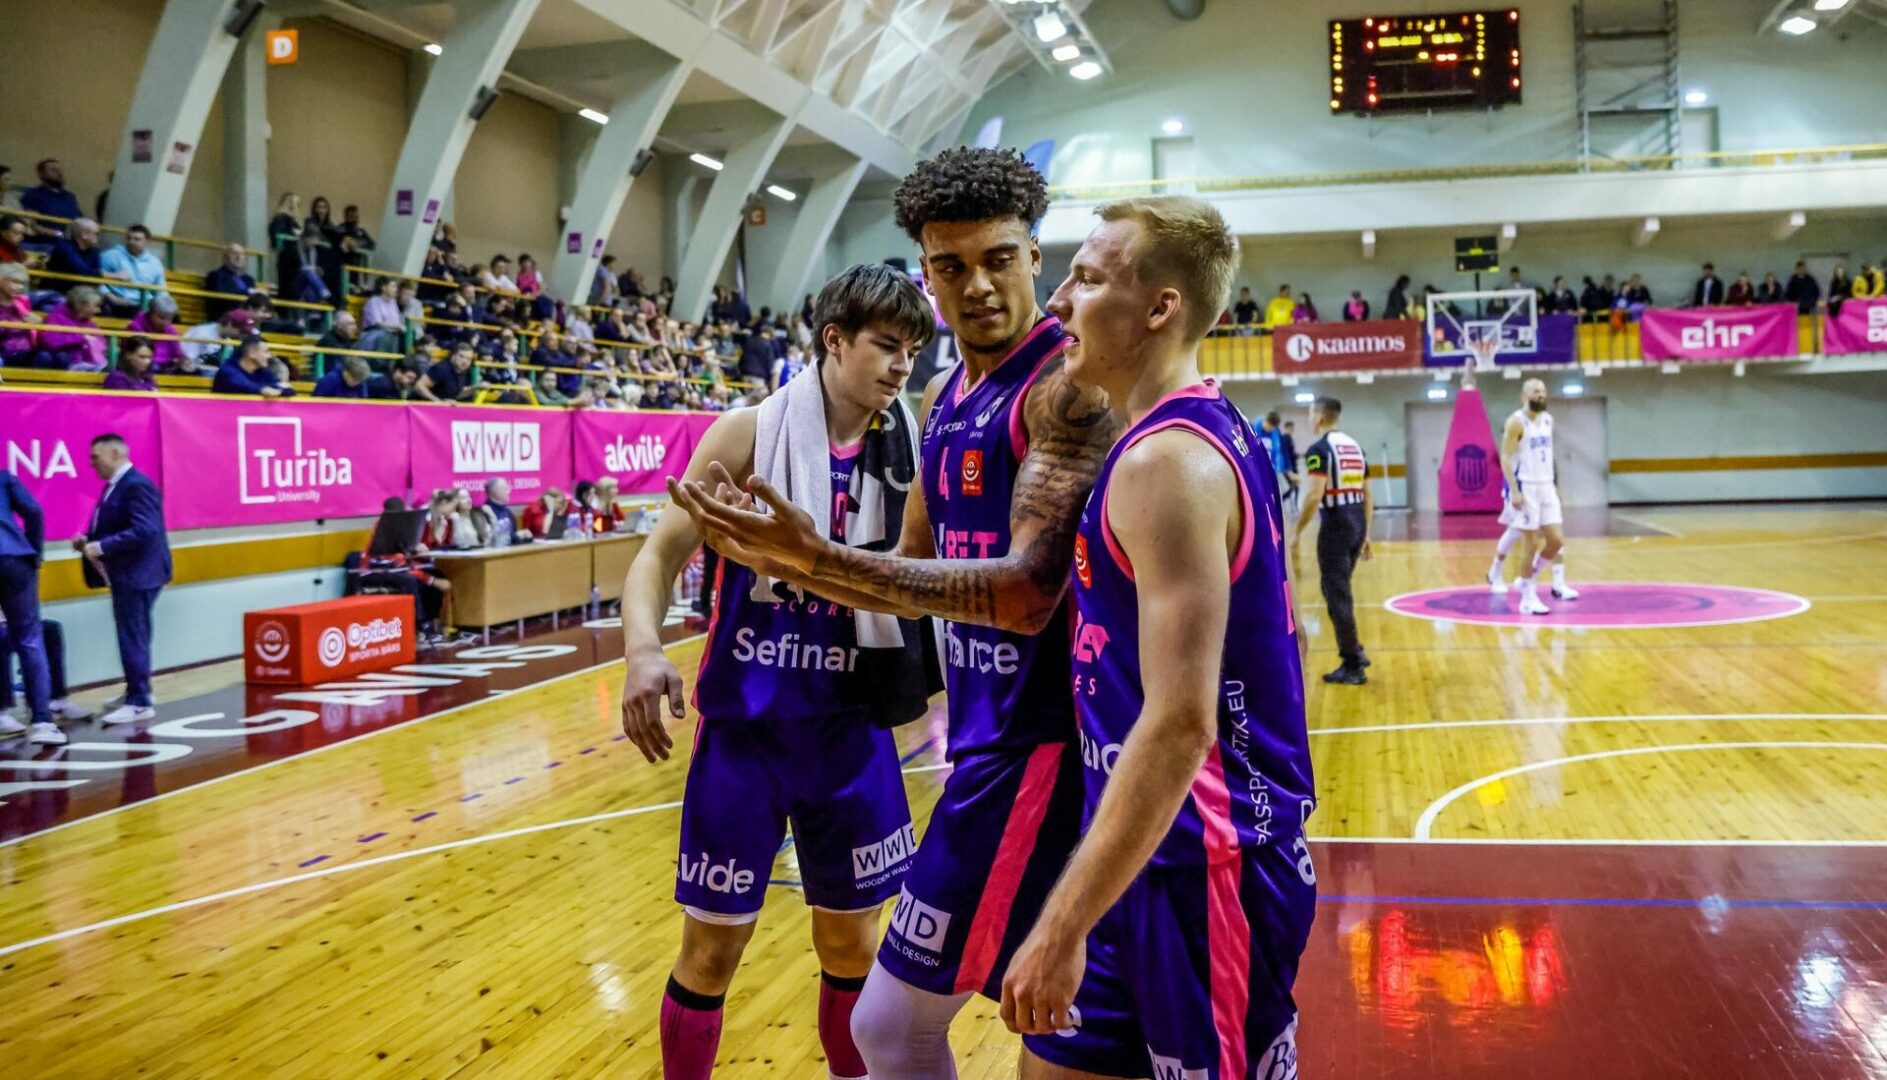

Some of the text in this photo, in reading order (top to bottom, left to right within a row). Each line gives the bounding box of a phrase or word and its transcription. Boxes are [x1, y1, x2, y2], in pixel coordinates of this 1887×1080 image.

[273, 36, 293, 59] D
[1681, 318, 1754, 350] ehr
[8, 438, 78, 479] NA
[456, 431, 535, 462] WWD
[604, 435, 667, 472] akvilė
[253, 448, 352, 488] Turība
[346, 617, 402, 649] Optibet
